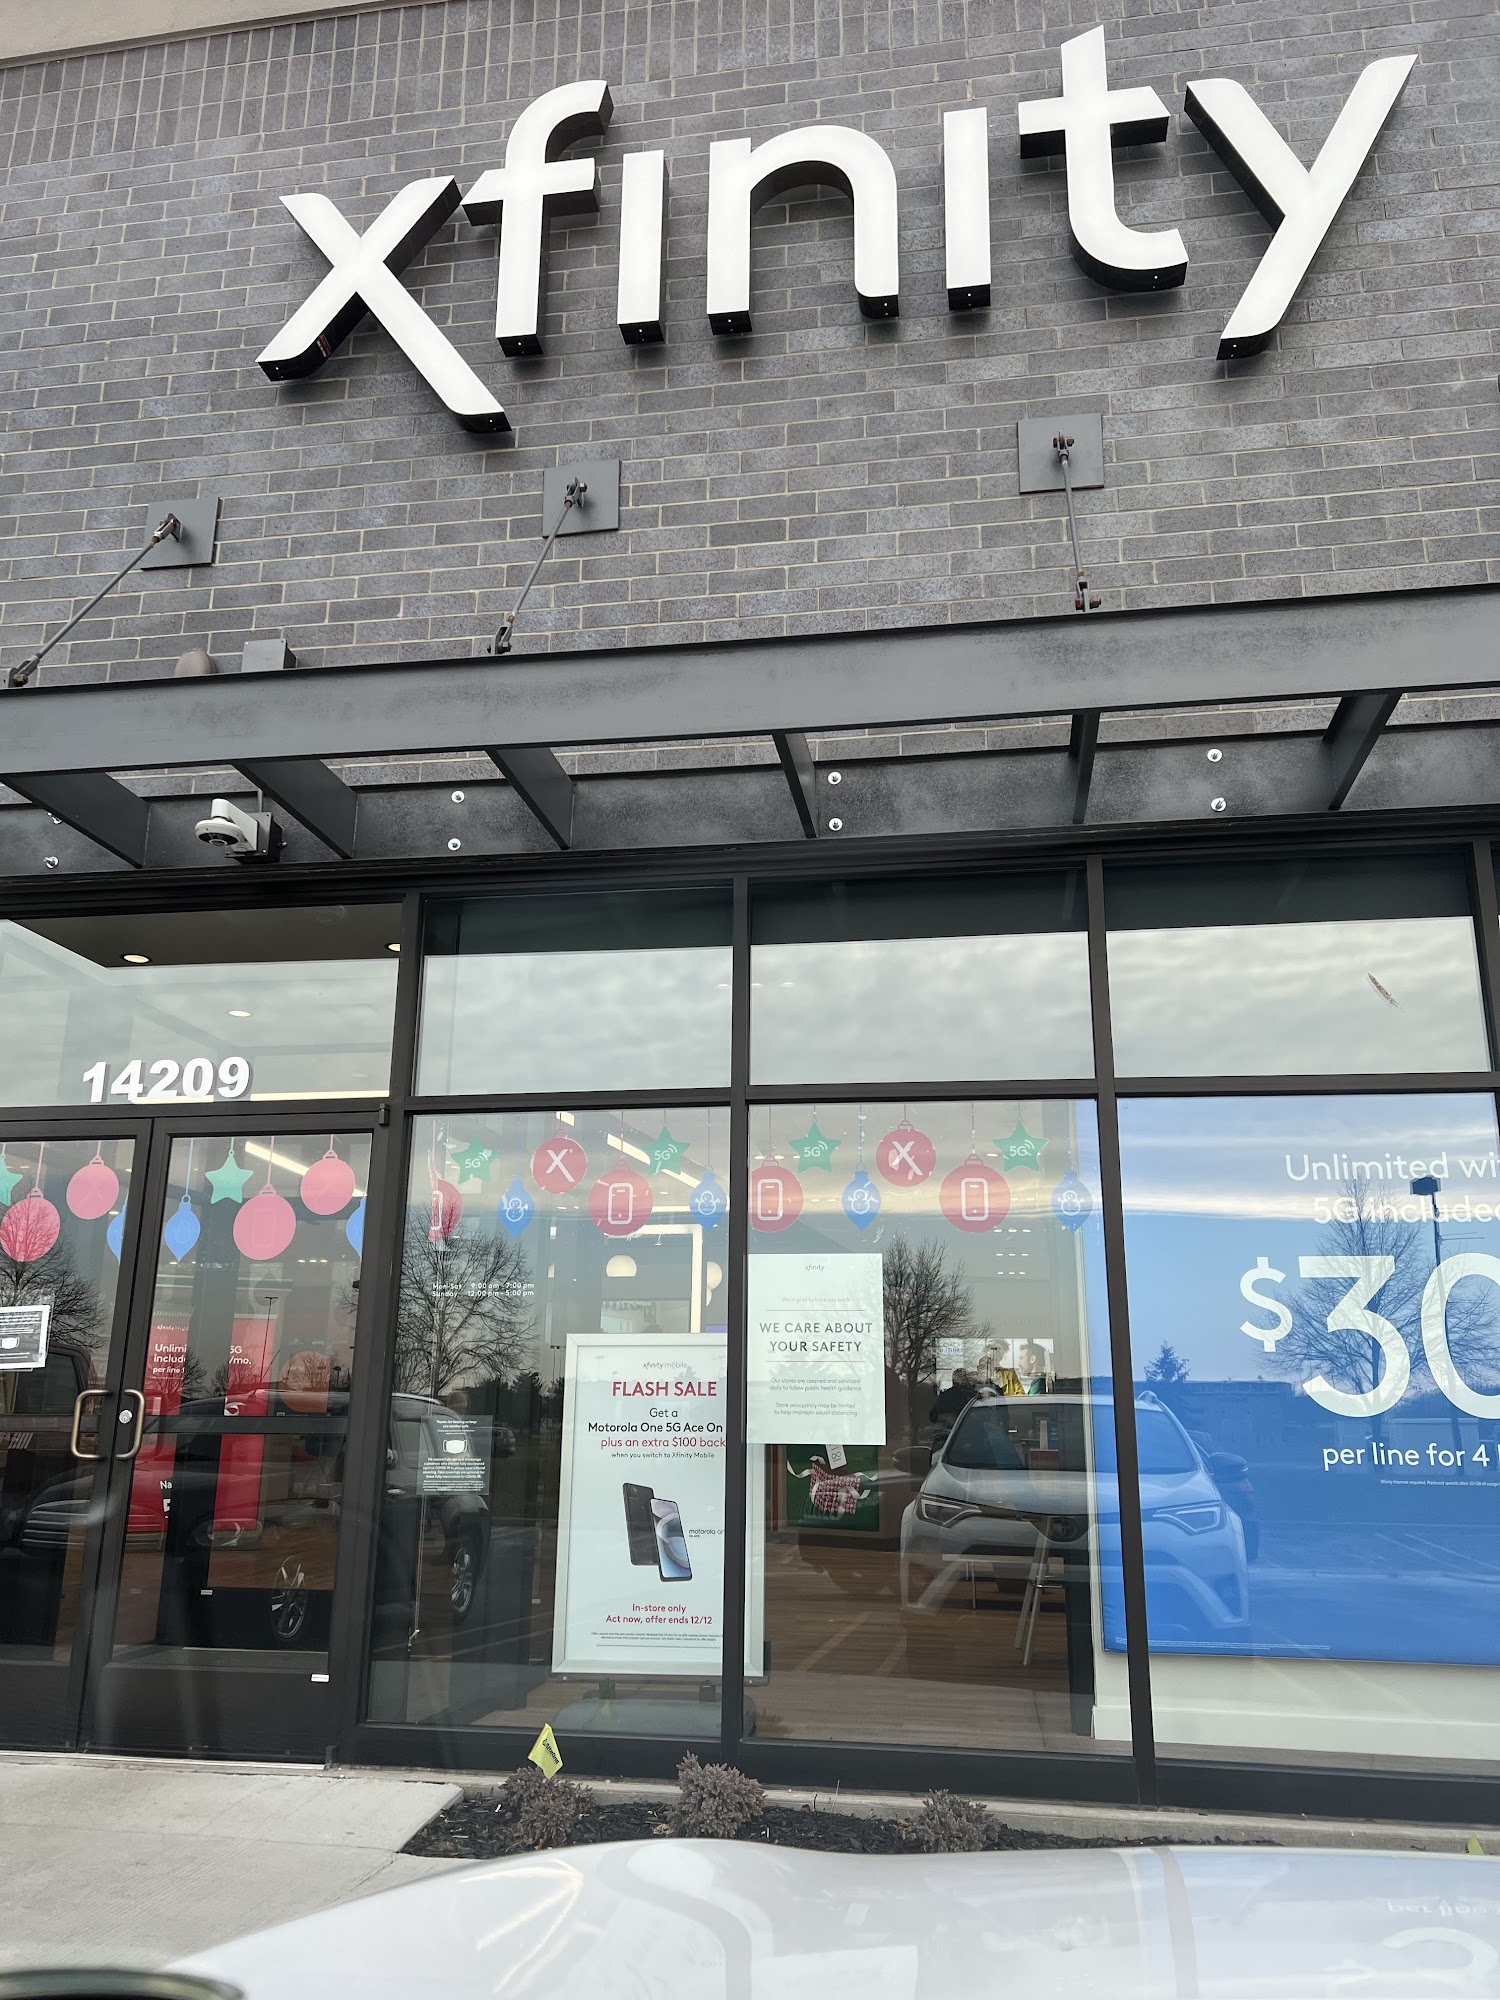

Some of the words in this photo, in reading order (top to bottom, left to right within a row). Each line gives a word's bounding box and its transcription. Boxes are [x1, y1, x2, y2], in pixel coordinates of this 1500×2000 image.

[257, 26, 1418, 432] xfinity
[82, 1056, 251, 1102] 14209
[654, 1149, 671, 1161] 5G
[803, 1146, 821, 1158] 5G
[1009, 1145, 1027, 1157] 5G
[464, 1158, 481, 1169] 5G
[1285, 1151, 1449, 1181] Unlimited
[1458, 1151, 1500, 1179] wi
[1314, 1196, 1359, 1224] 5G
[804, 1263, 825, 1272] xfinity
[432, 1282, 462, 1290] Mon-Sat
[432, 1290, 458, 1298] Sunday
[760, 1322, 780, 1333] WE
[784, 1322, 820, 1333] CARE
[825, 1322, 873, 1333] ABOUT
[155, 1343, 187, 1353] Unlimi
[770, 1341, 808, 1352] YOUR
[812, 1341, 862, 1352] SAFETY
[643, 1361, 664, 1369] xfinity
[152, 1367, 165, 1375] per
[612, 1381, 669, 1397] FLASH
[674, 1381, 717, 1397] SALE
[650, 1408, 669, 1418] Get
[672, 1410, 678, 1418] a
[588, 1422, 638, 1432] Motorola
[640, 1422, 663, 1432] One
[666, 1422, 681, 1432] 5G
[683, 1422, 704, 1432] Ace
[706, 1422, 723, 1432] On
[600, 1437, 622, 1450] plus
[625, 1439, 639, 1447] an
[642, 1438, 670, 1447] extra
[672, 1436, 697, 1448] $100
[700, 1437, 726, 1447] back
[1323, 1448, 1365, 1471] per
[1372, 1442, 1420, 1466] line
[1426, 1443, 1466, 1466] for
[1472, 1444, 1490, 1467] 4
[632, 1604, 666, 1612] In-store
[668, 1604, 687, 1614] only
[606, 1614, 621, 1623] Act
[622, 1616, 643, 1624] now,
[645, 1615, 666, 1624] offer
[668, 1616, 689, 1624] ends
[690, 1616, 713, 1624] 12/12
